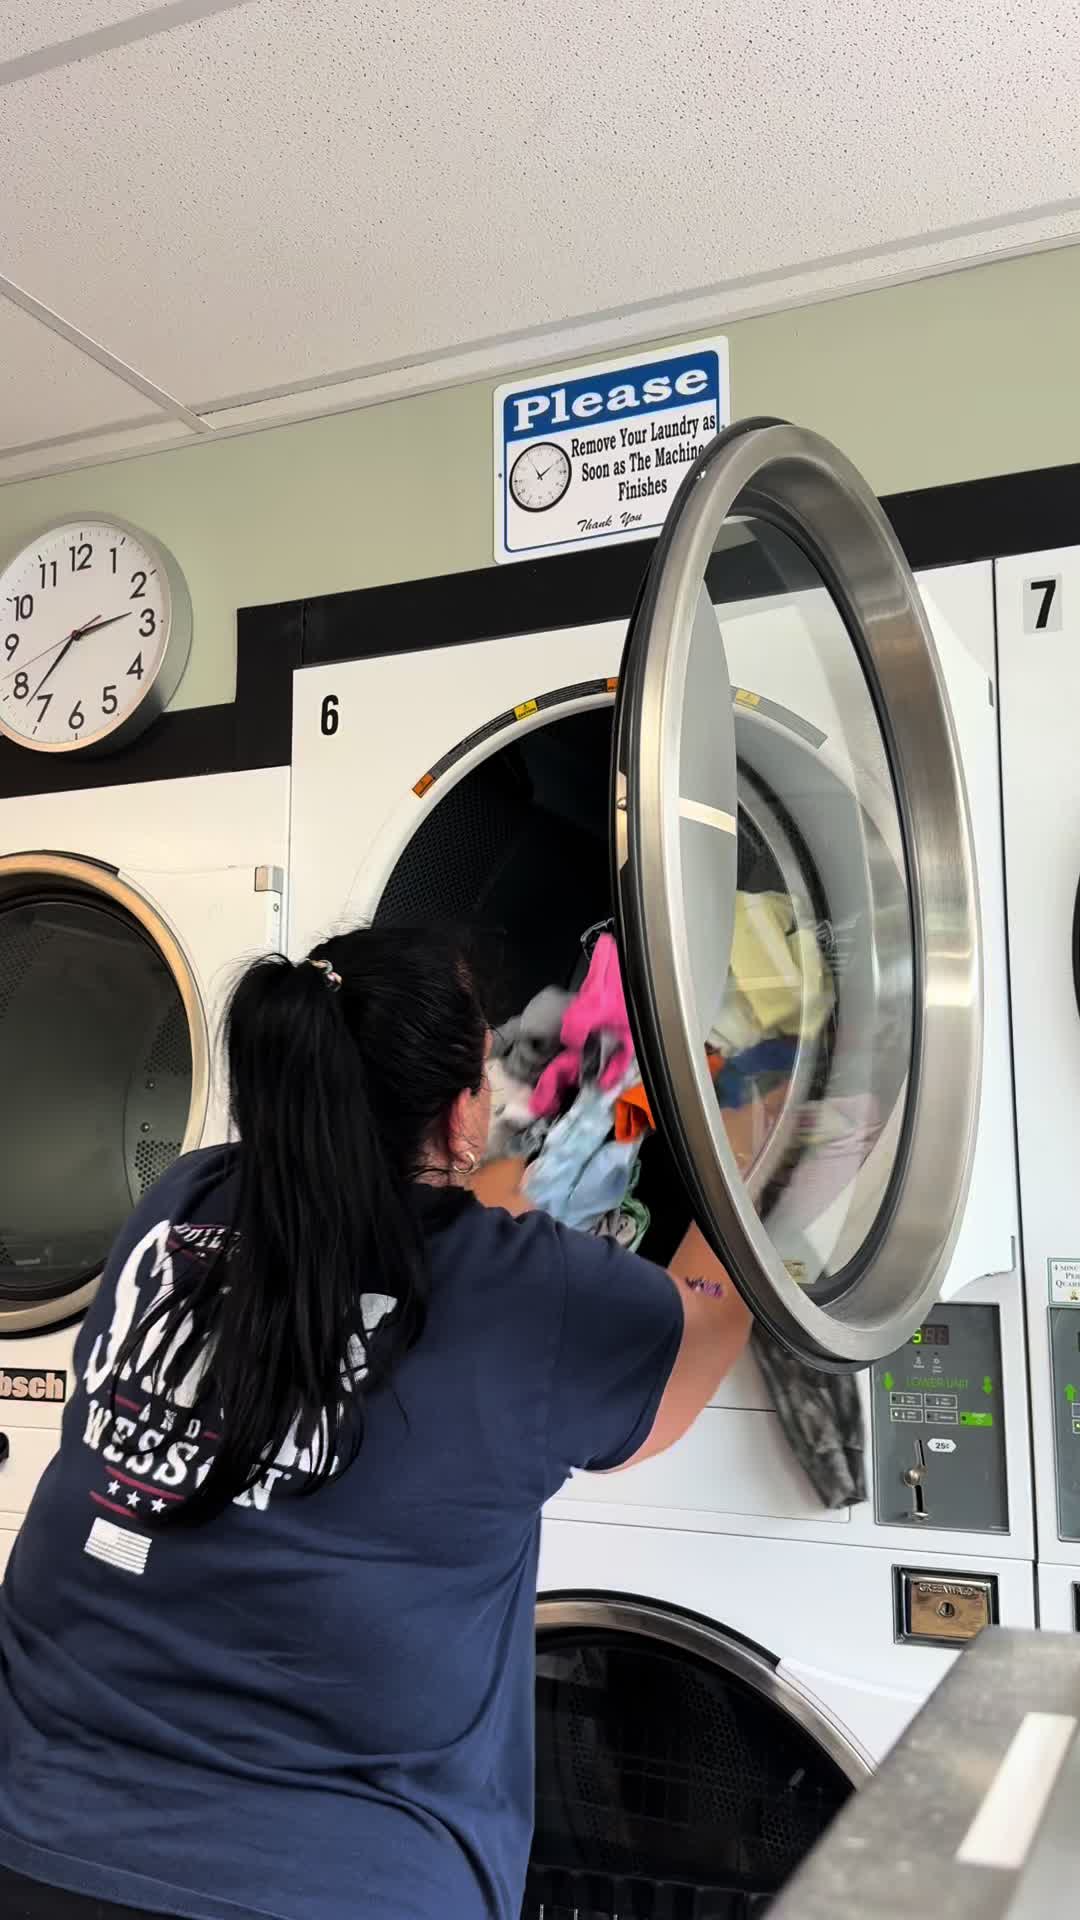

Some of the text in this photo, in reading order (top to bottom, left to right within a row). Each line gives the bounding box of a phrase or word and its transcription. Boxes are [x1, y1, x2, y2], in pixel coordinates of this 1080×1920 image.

[513, 369, 708, 432] Please
[571, 415, 715, 458] Remove Your Laundry as
[582, 462, 609, 482] Soon
[613, 461, 626, 475] as
[629, 453, 651, 472] The
[618, 478, 667, 502] Finishes
[576, 512, 643, 533] Thank You
[69, 543, 93, 572] 12
[109, 548, 117, 574] 1
[39, 561, 58, 589] 11
[129, 571, 147, 599] 2
[13, 594, 34, 621] 10
[1031, 579, 1056, 629] 7
[138, 608, 156, 637] 3
[5, 633, 20, 661] 9
[126, 651, 144, 680] 4
[13, 671, 29, 699] 8
[101, 685, 118, 714] 5
[37, 693, 53, 723] 7
[68, 700, 85, 730] 6
[321, 694, 339, 735] 6
